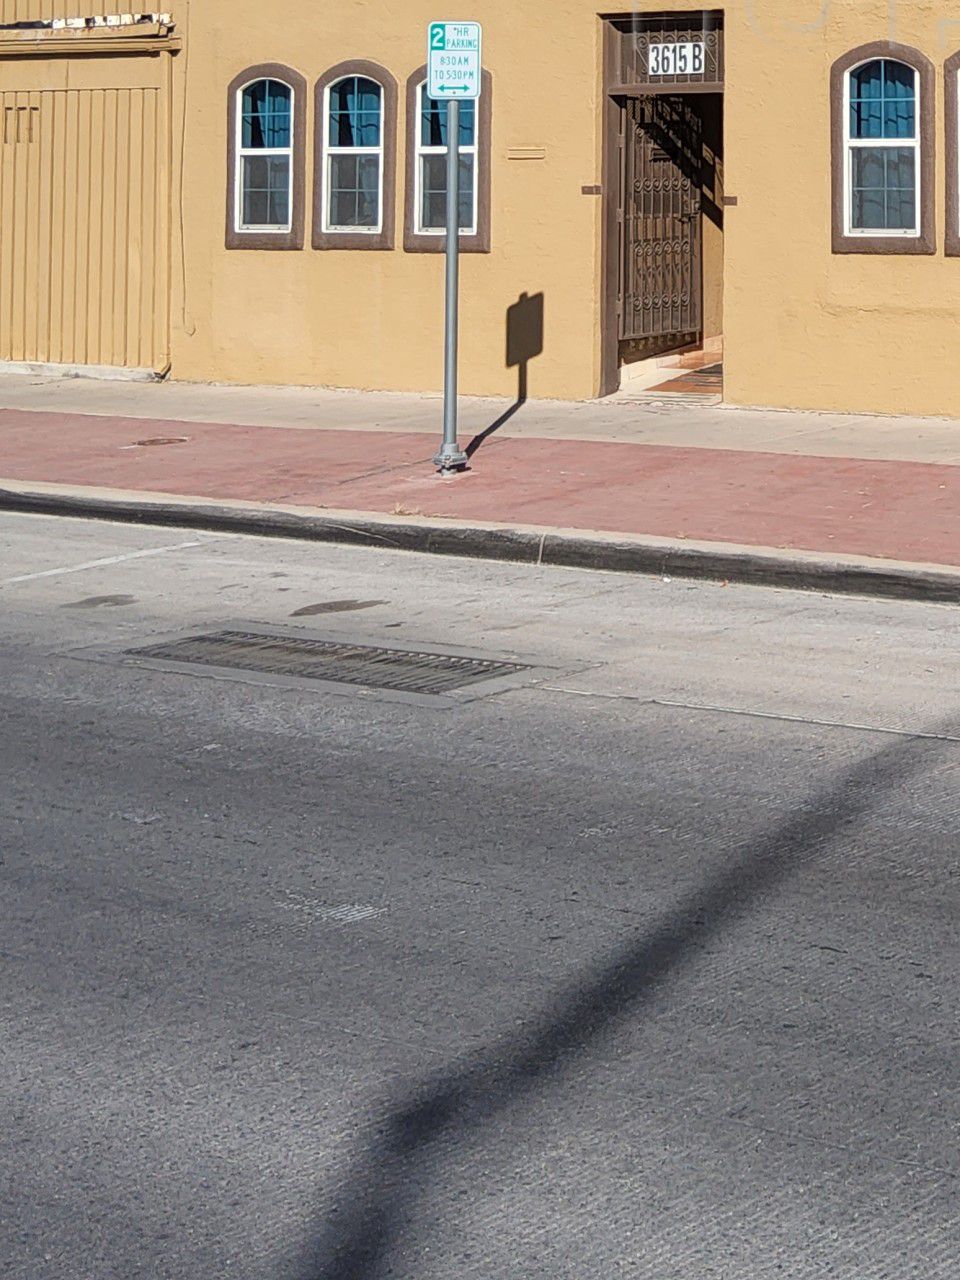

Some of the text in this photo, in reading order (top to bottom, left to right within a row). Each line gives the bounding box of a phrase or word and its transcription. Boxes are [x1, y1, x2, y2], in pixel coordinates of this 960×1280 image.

[456, 27, 469, 36] HR
[431, 27, 444, 47] 2
[447, 39, 477, 48] PARKING
[651, 44, 702, 73] 3615 B
[434, 70, 444, 79] TO
